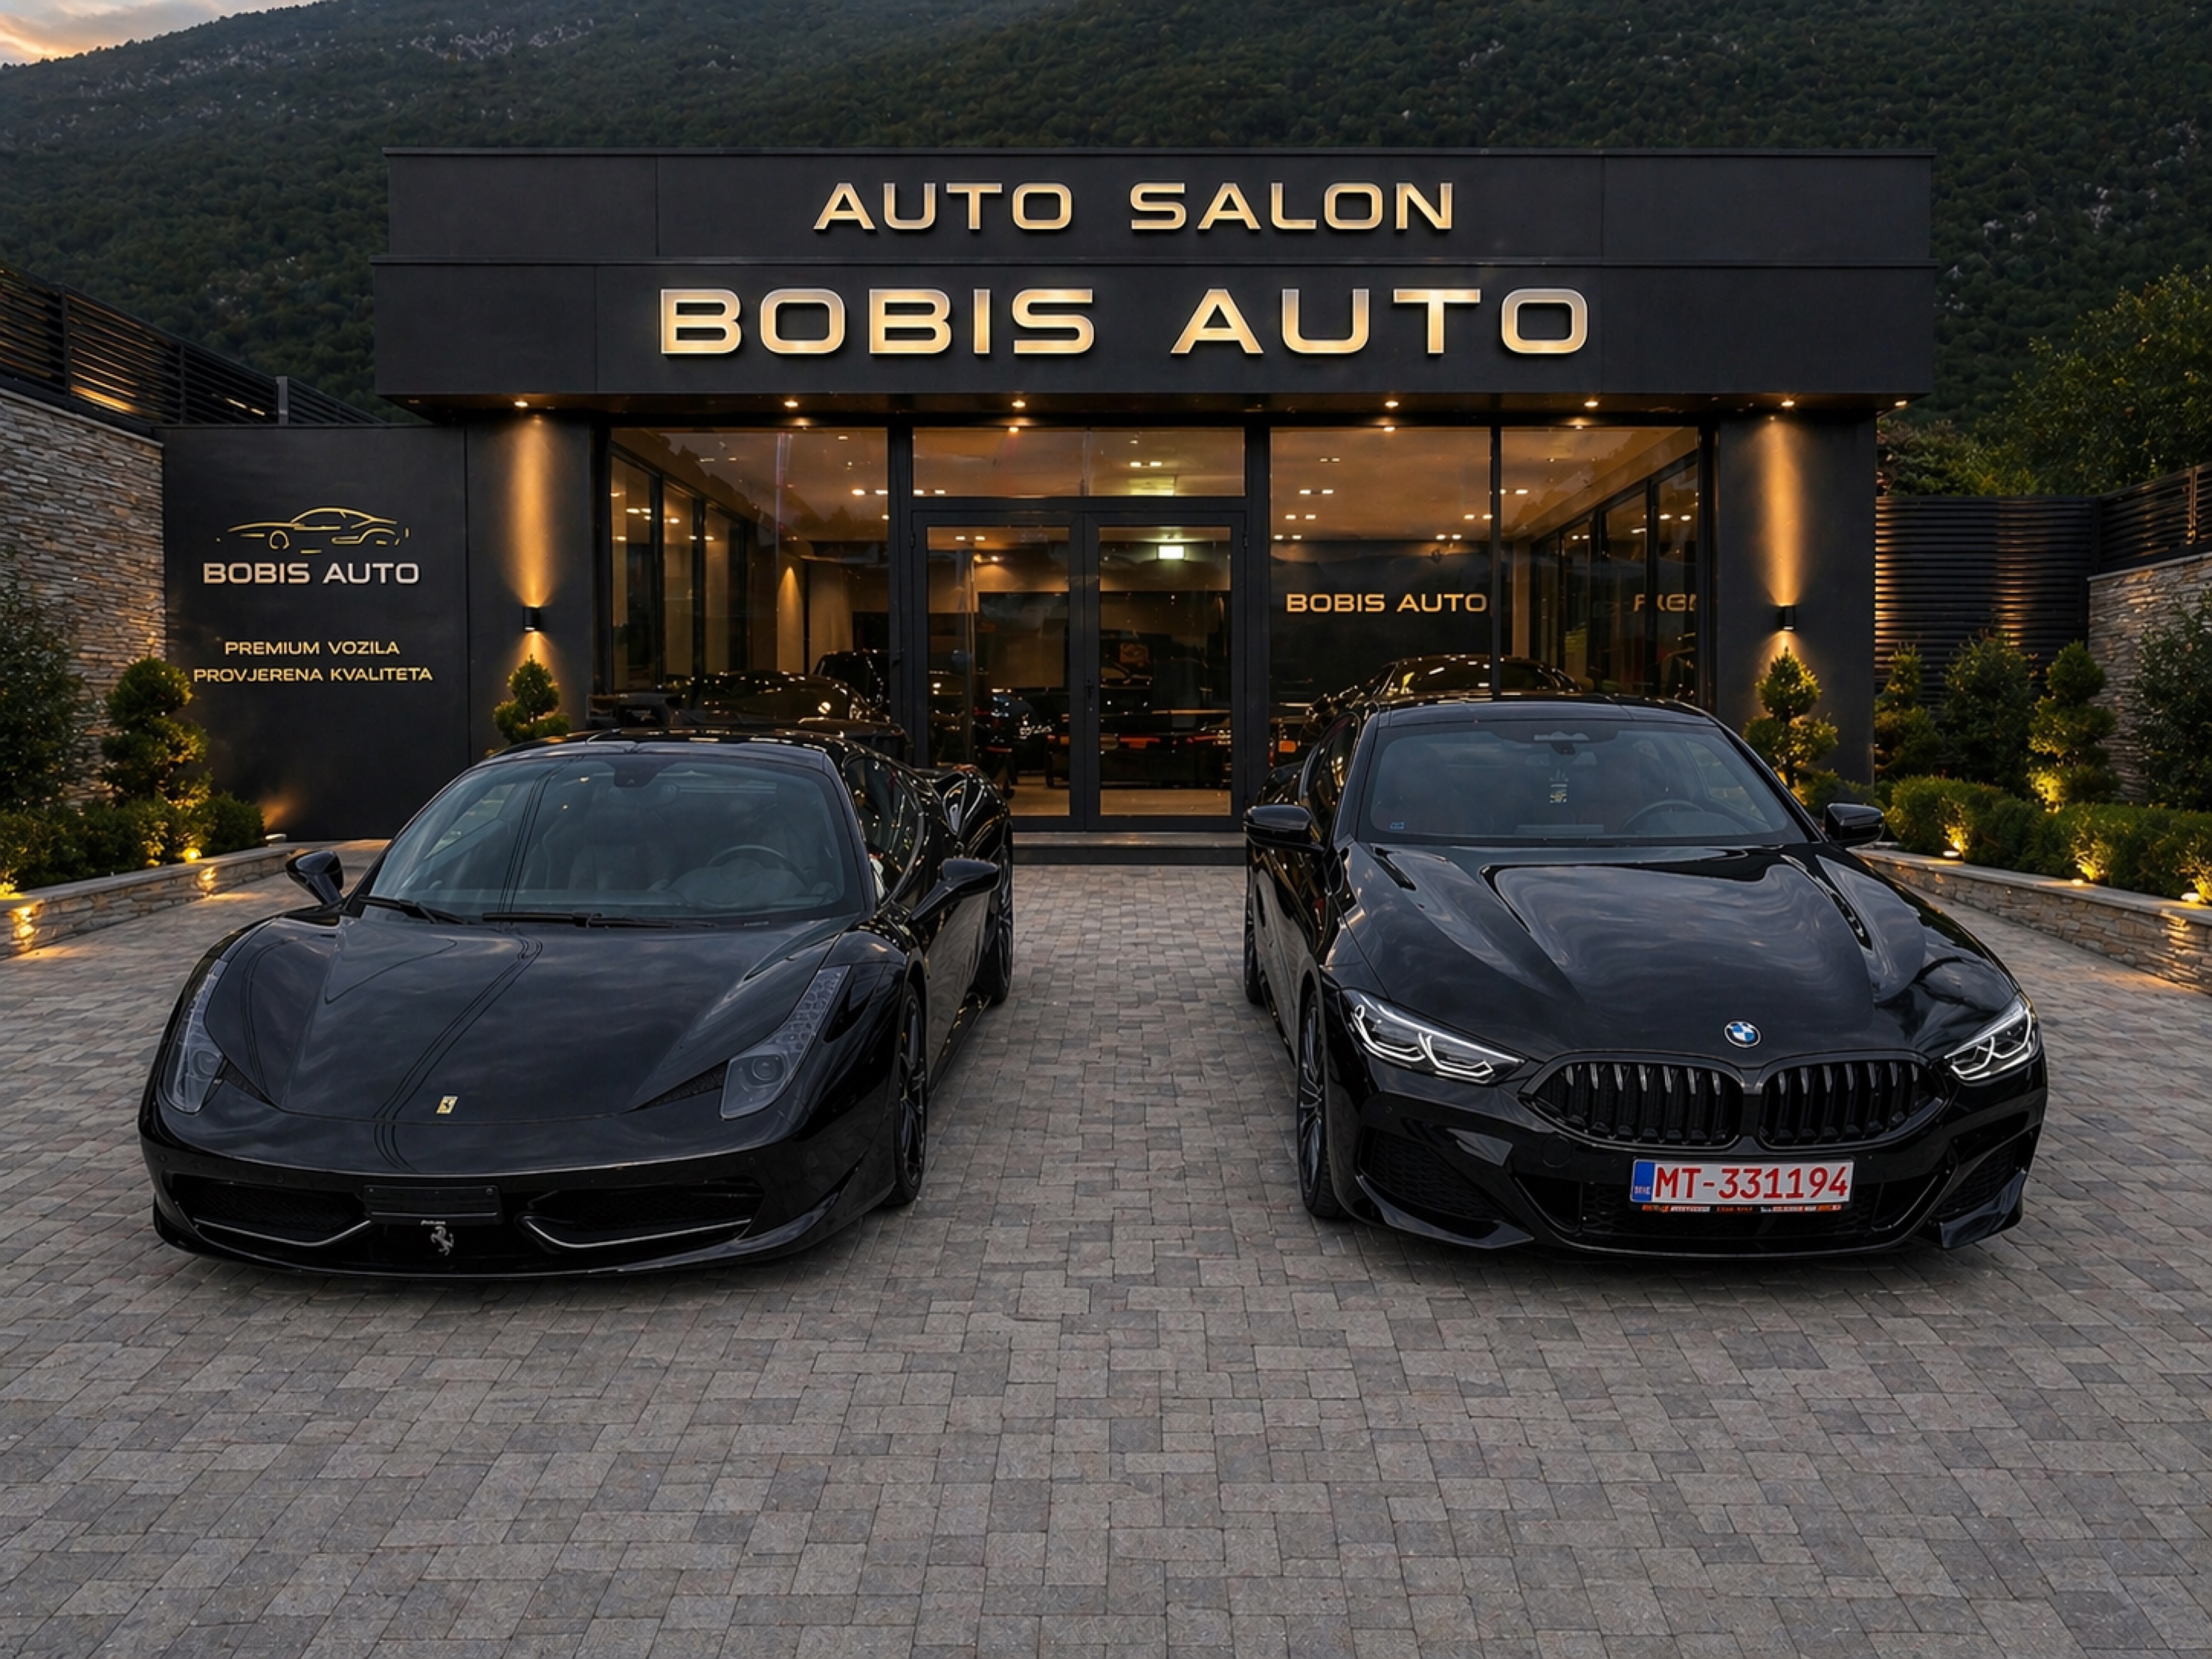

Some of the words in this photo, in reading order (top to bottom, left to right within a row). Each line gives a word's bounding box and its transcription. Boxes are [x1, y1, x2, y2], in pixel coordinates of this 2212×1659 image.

[814, 183, 1072, 230] AUTO
[1130, 183, 1453, 230] SALON
[661, 288, 1094, 354] BOBIS
[1170, 288, 1588, 354] AUTO
[204, 563, 310, 584] BOBIS
[323, 563, 419, 584] AUTO
[1286, 593, 1386, 612] BOBIS
[1396, 593, 1486, 612] AUTO
[225, 641, 320, 655] PREMIUM
[328, 641, 400, 654] VOZILA
[194, 668, 324, 683] PROVJERENA
[330, 667, 433, 682] KVALITETA
[1654, 1167, 1847, 1199] MT-331194
